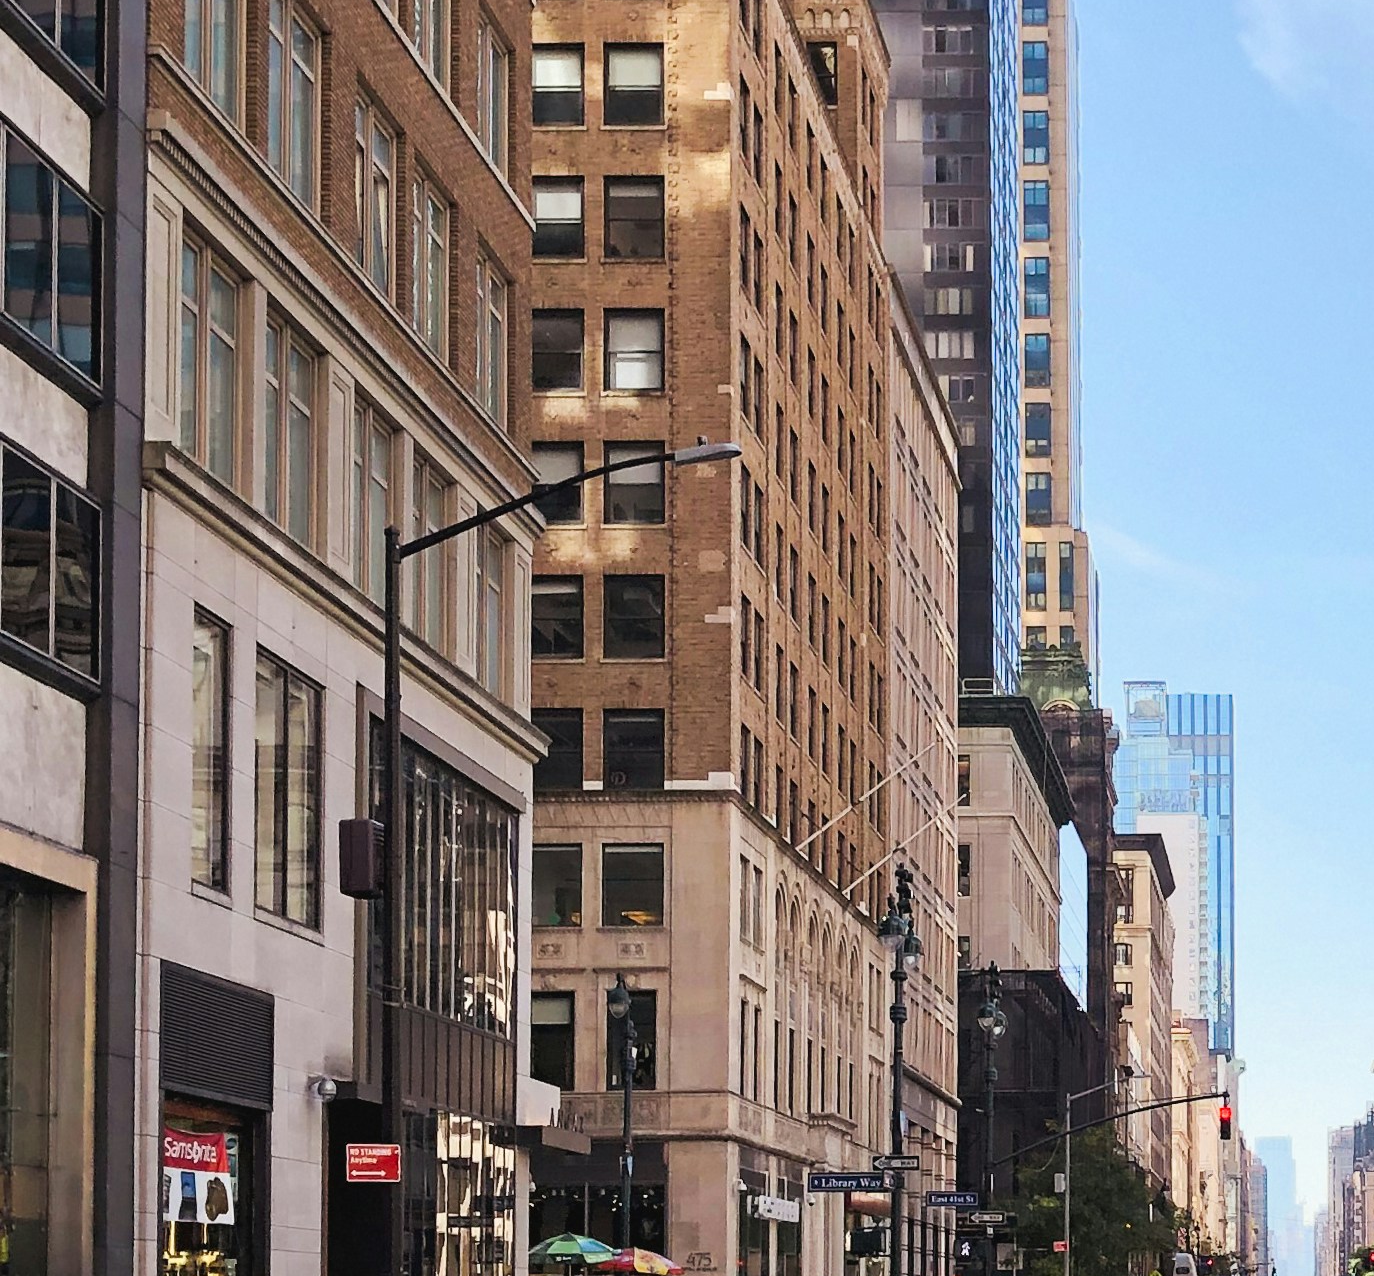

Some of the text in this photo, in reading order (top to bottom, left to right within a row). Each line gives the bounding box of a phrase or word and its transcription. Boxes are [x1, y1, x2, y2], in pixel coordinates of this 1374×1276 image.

[821, 1177, 882, 1189] Library Way
[931, 1195, 948, 1203] East
[965, 1195, 975, 1203] St
[686, 1252, 712, 1267] 475
